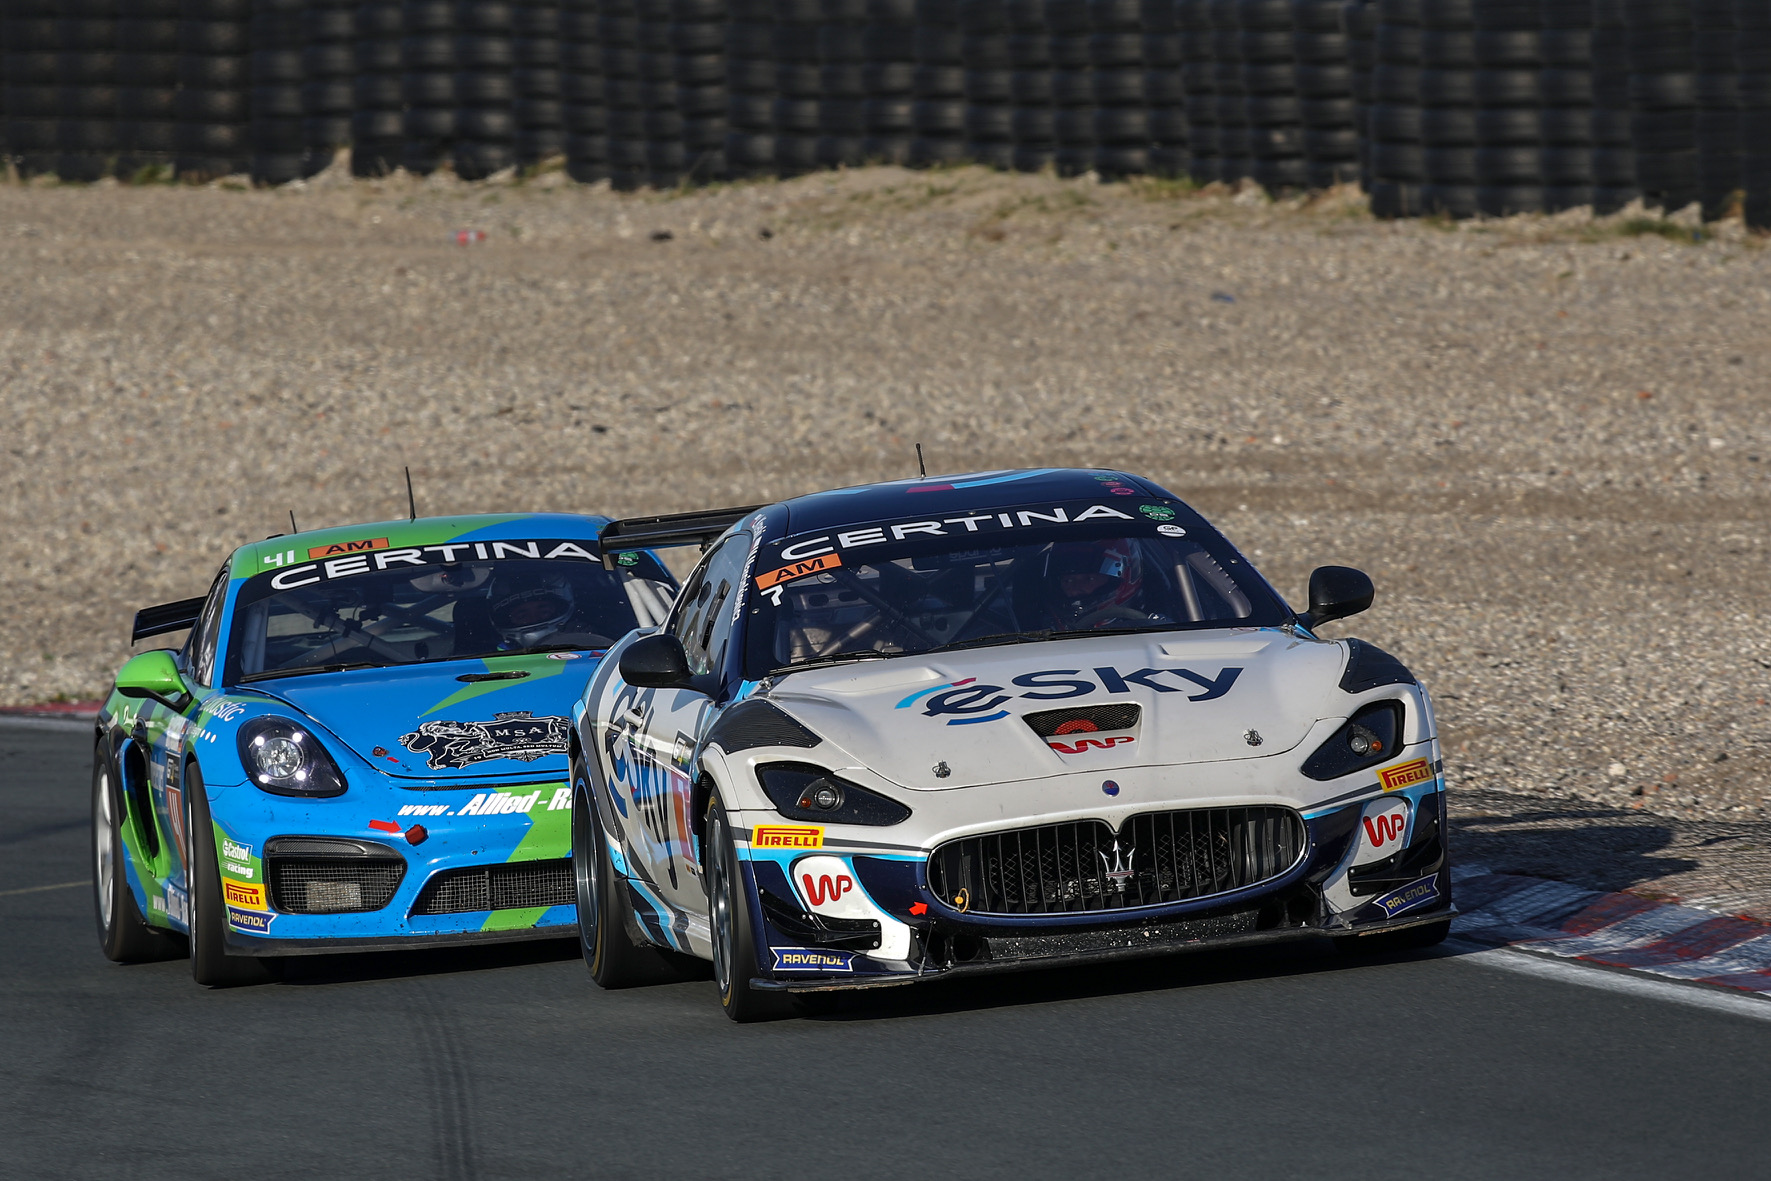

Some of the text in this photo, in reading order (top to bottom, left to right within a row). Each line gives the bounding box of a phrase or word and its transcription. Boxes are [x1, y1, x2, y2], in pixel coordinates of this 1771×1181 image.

[781, 505, 1135, 560] CERTINA
[326, 540, 373, 555] AM
[263, 550, 295, 567] 41
[271, 540, 601, 590] CERTINA
[775, 558, 825, 582] AM
[760, 584, 784, 607] 7
[1381, 760, 1430, 789] PIRELLI
[756, 828, 820, 847] PIRELLI
[228, 842, 250, 862] Castrol
[227, 862, 254, 878] racing
[226, 883, 260, 905] PIRELLI
[1385, 883, 1431, 909] RAVENOL
[231, 912, 265, 927] RAVENOL
[782, 954, 845, 966] RAVENOL
